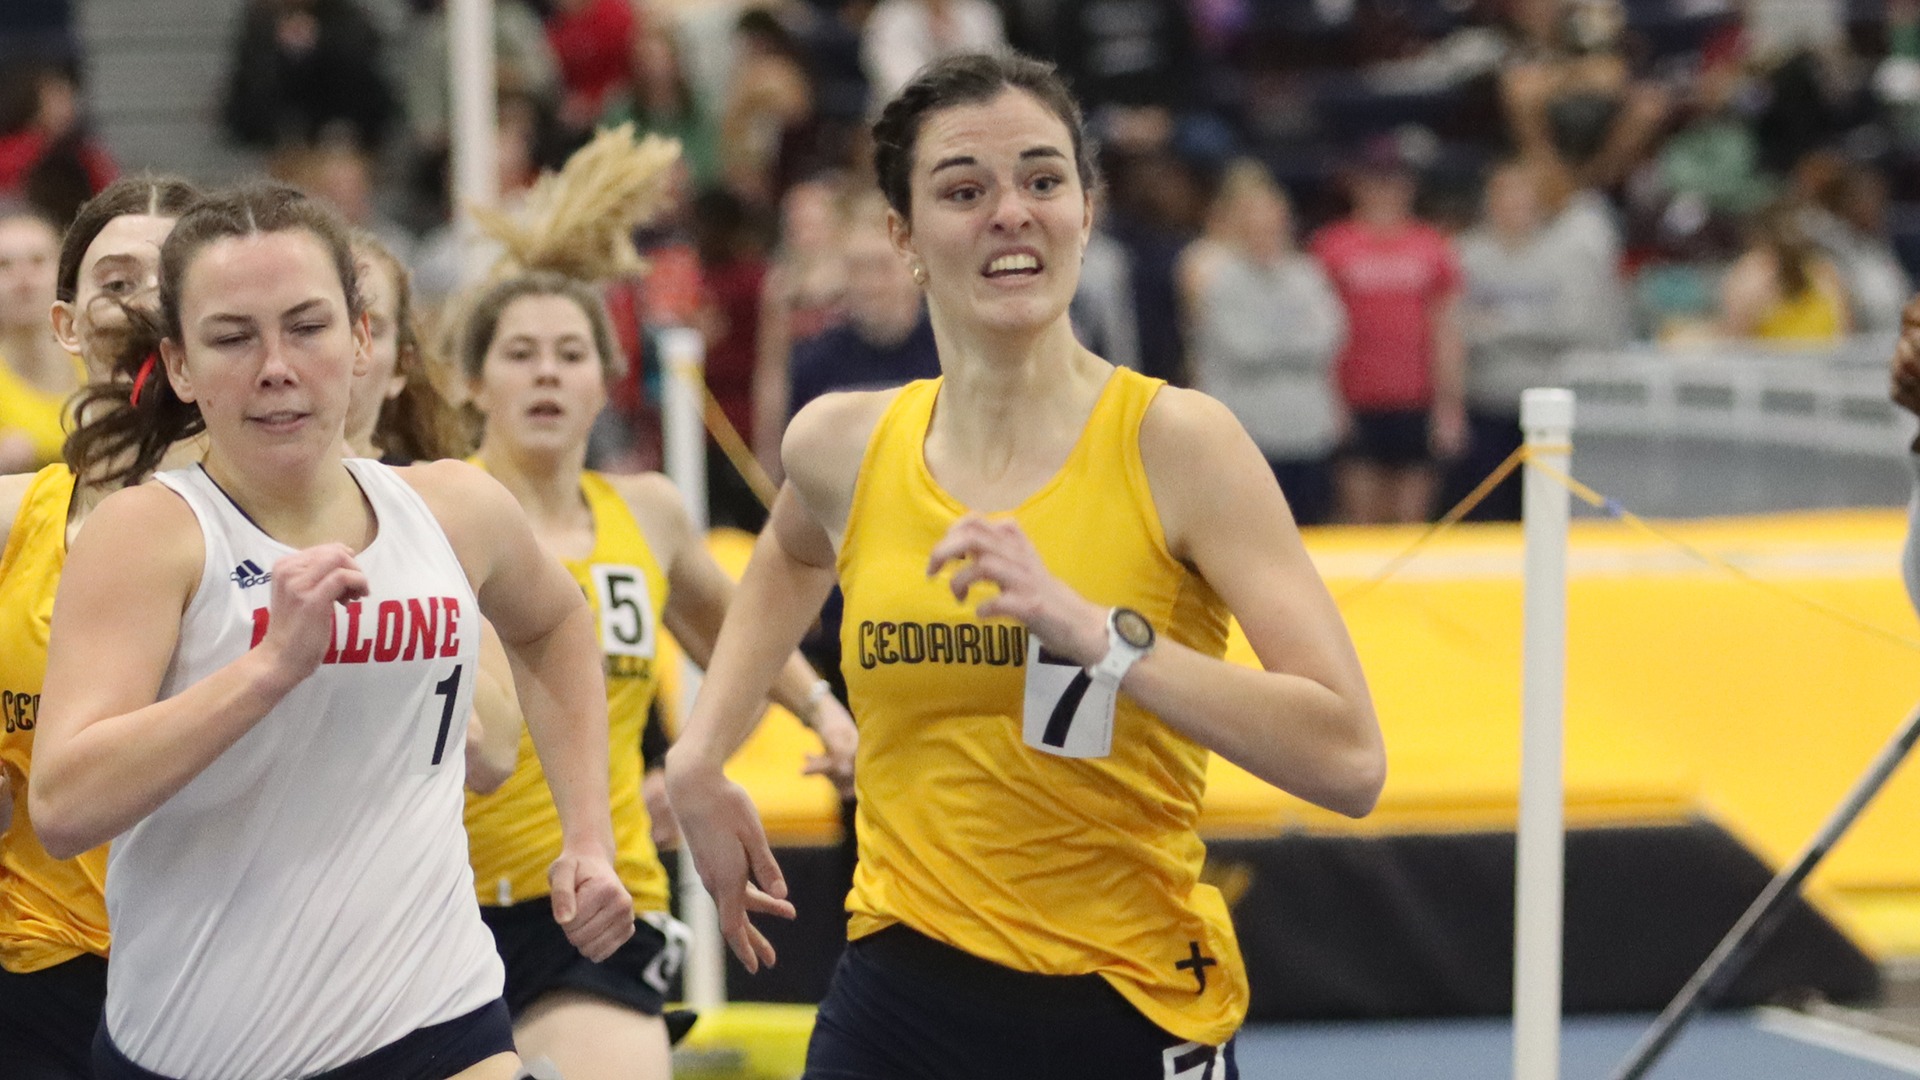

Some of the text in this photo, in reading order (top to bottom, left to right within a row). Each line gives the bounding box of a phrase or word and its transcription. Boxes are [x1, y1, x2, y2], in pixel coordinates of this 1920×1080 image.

[250, 597, 460, 664] LONE
[606, 573, 643, 645] 5
[858, 620, 1029, 669] CEDARVI
[431, 664, 463, 765] 1
[1038, 644, 1094, 748] 7
